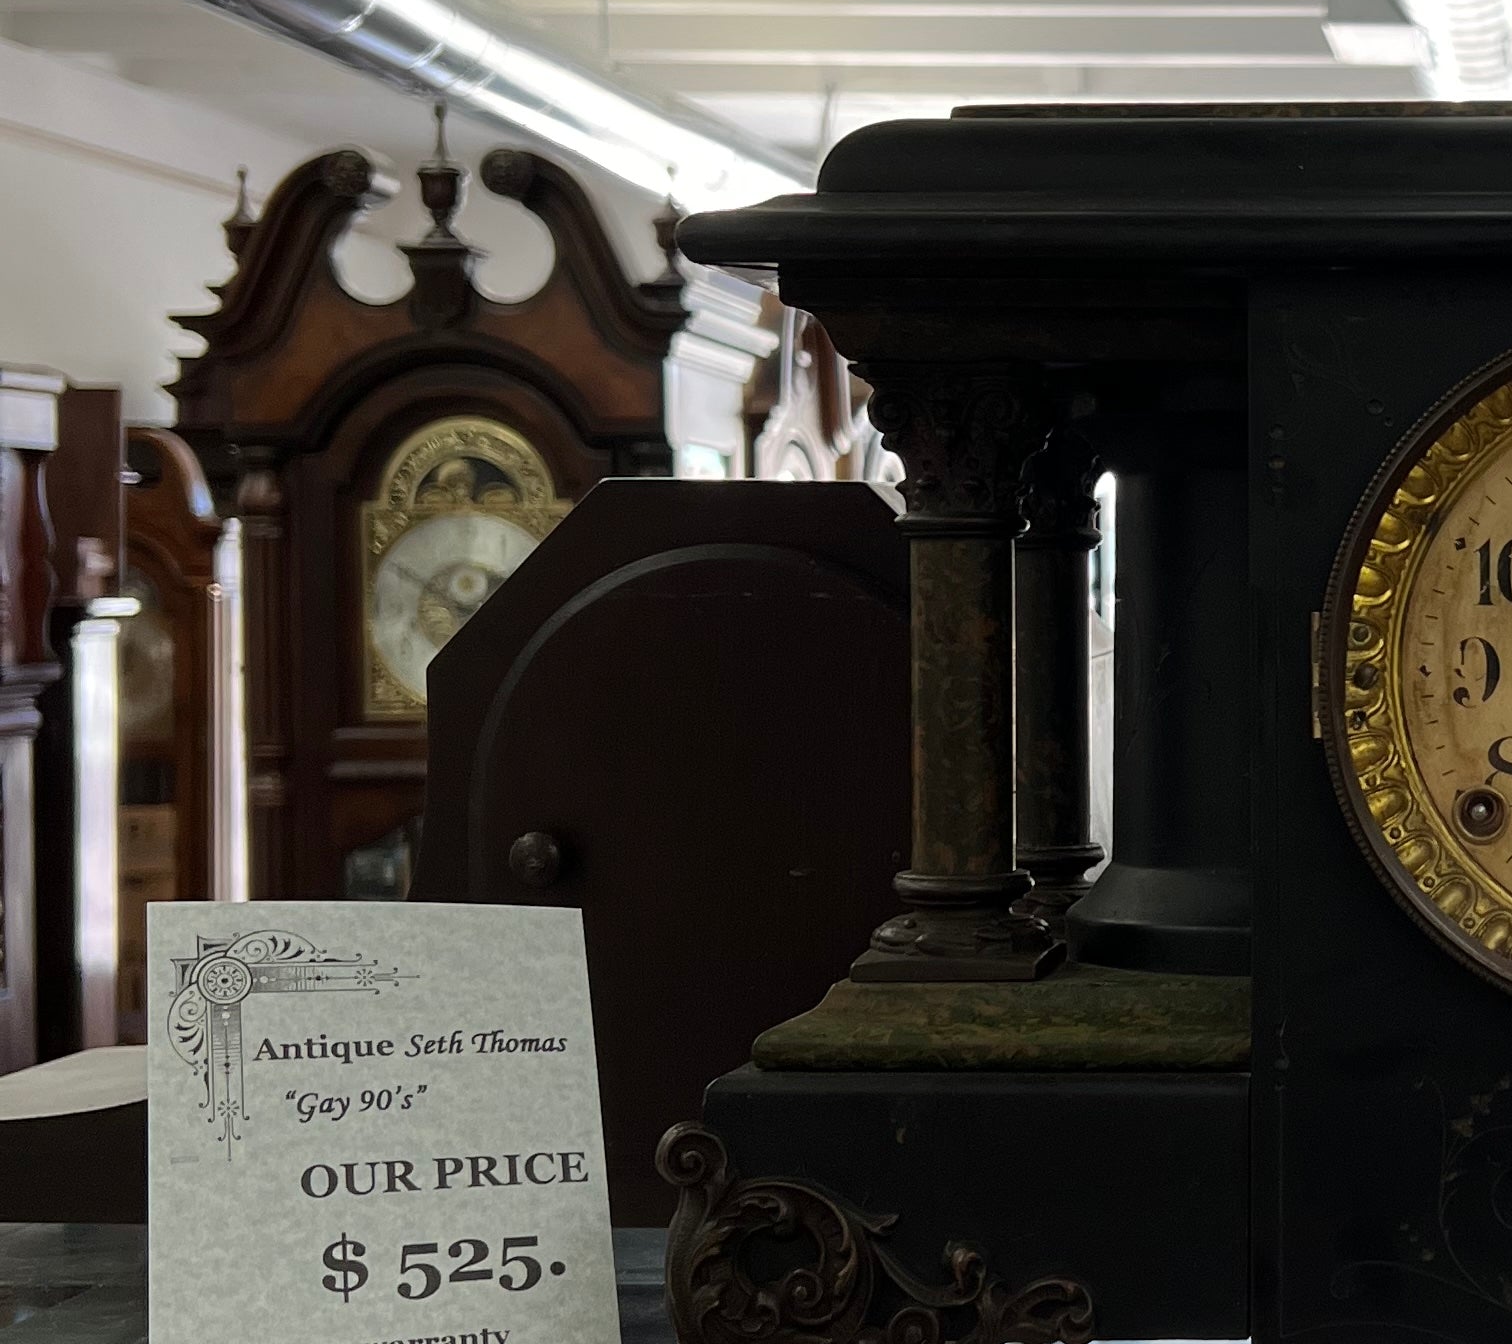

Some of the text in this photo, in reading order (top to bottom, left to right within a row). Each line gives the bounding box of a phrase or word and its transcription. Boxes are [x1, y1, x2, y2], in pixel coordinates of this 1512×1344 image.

[1453, 637, 1500, 707] 9
[252, 1029, 569, 1064] Antique Seth Thomas
[285, 1090, 350, 1123] “Gay
[300, 1151, 590, 1198] OUR PRICE
[322, 1232, 567, 1303] $ 525.
